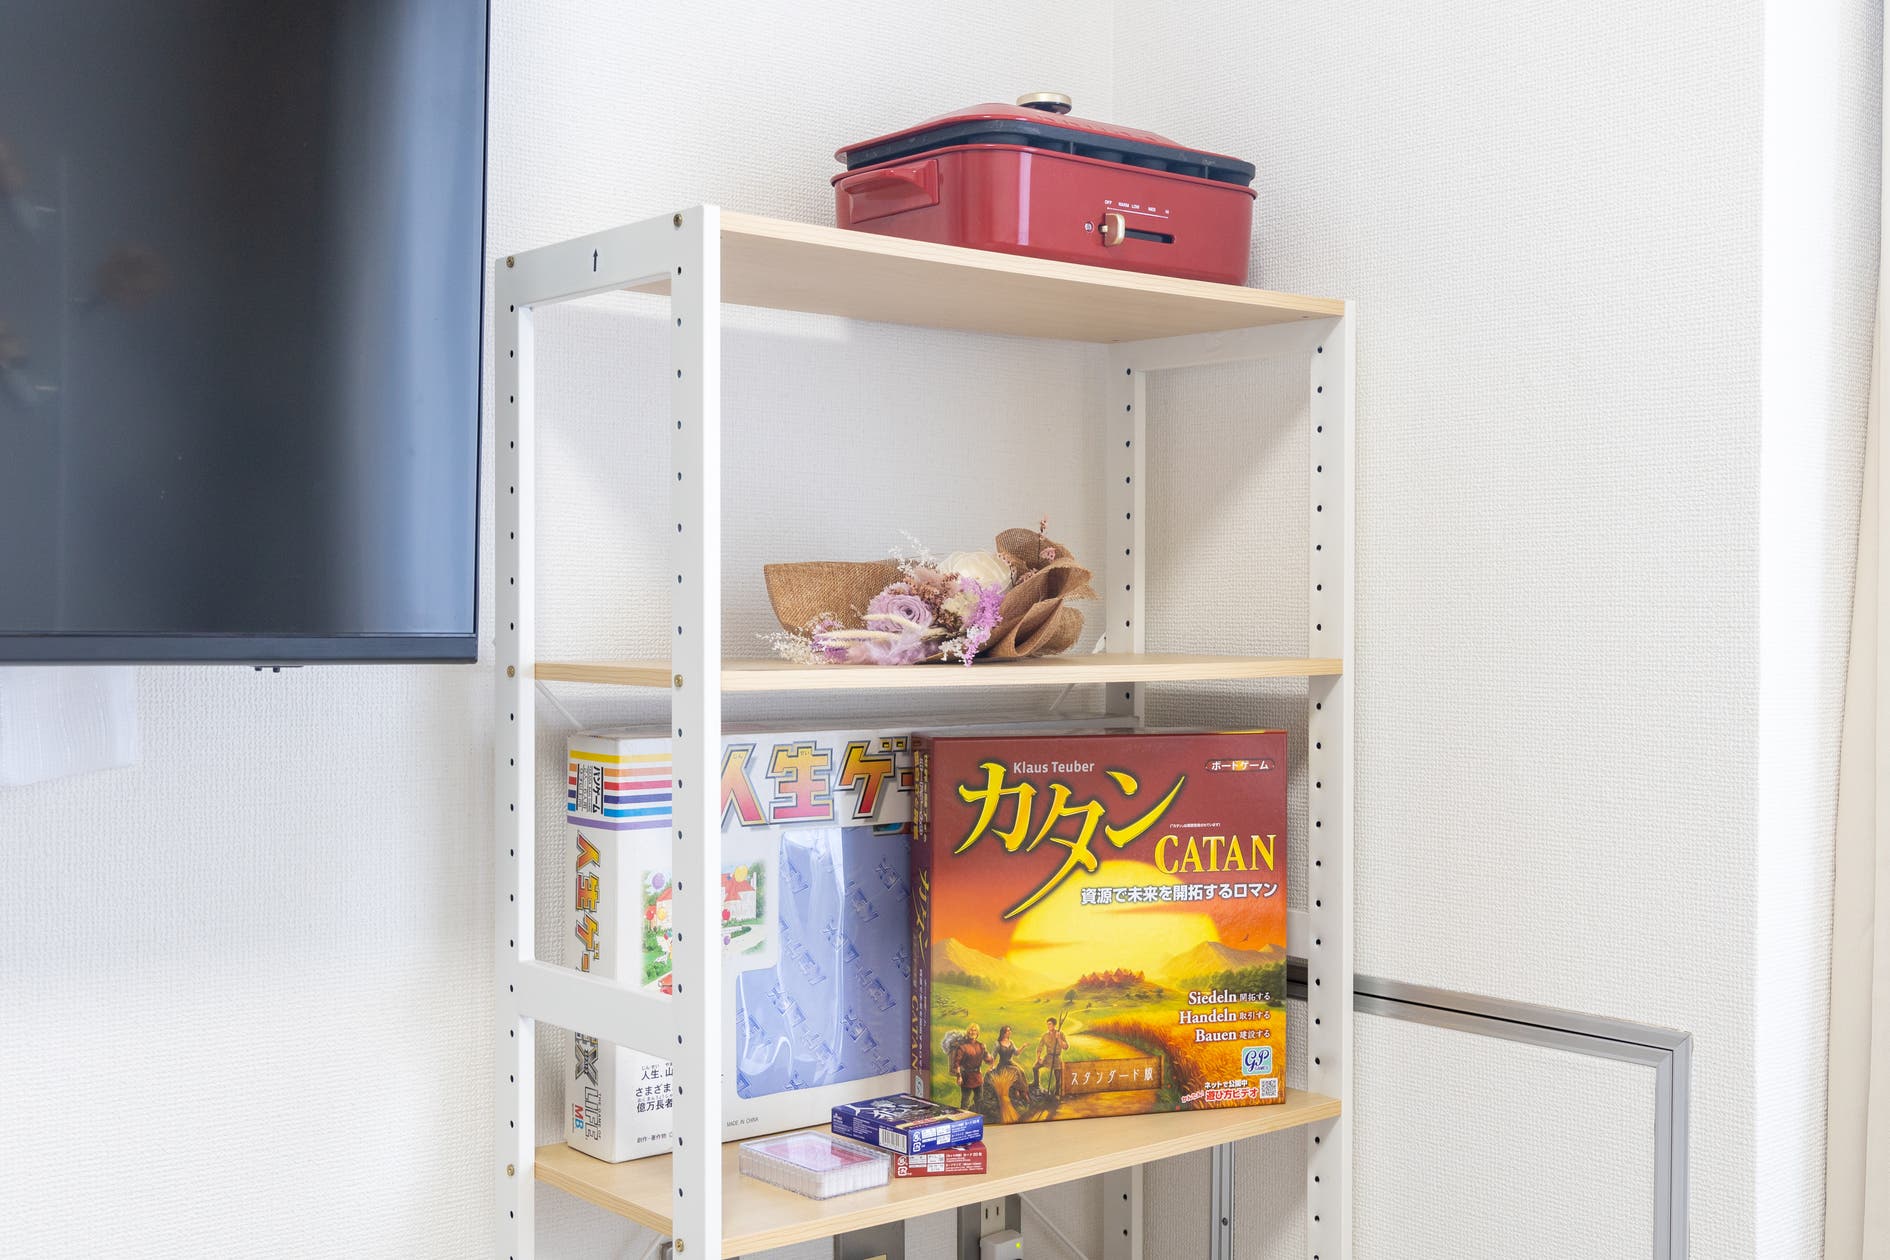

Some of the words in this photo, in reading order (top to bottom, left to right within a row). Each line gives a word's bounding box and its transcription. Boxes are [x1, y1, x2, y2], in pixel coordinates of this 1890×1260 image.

[1013, 760, 1048, 774] Klaus
[1052, 760, 1095, 773] Teuber
[1211, 760, 1270, 771] ボードゲーム
[954, 762, 1185, 919] カタン
[1154, 833, 1277, 875] CATAN
[1080, 883, 1278, 905] 資源で未来を開拓するロマン
[1188, 990, 1237, 1005] Siedeln
[1179, 1008, 1237, 1024] Handeln
[1239, 1011, 1271, 1021] 取引する
[1194, 1029, 1237, 1043] Bauen
[1245, 1049, 1270, 1072] GP
[1071, 1067, 1153, 1086] スタンダード版
[635, 1083, 671, 1097] さまざま
[1205, 1087, 1258, 1102] 遊び方ビデオ
[574, 1104, 584, 1129] MB
